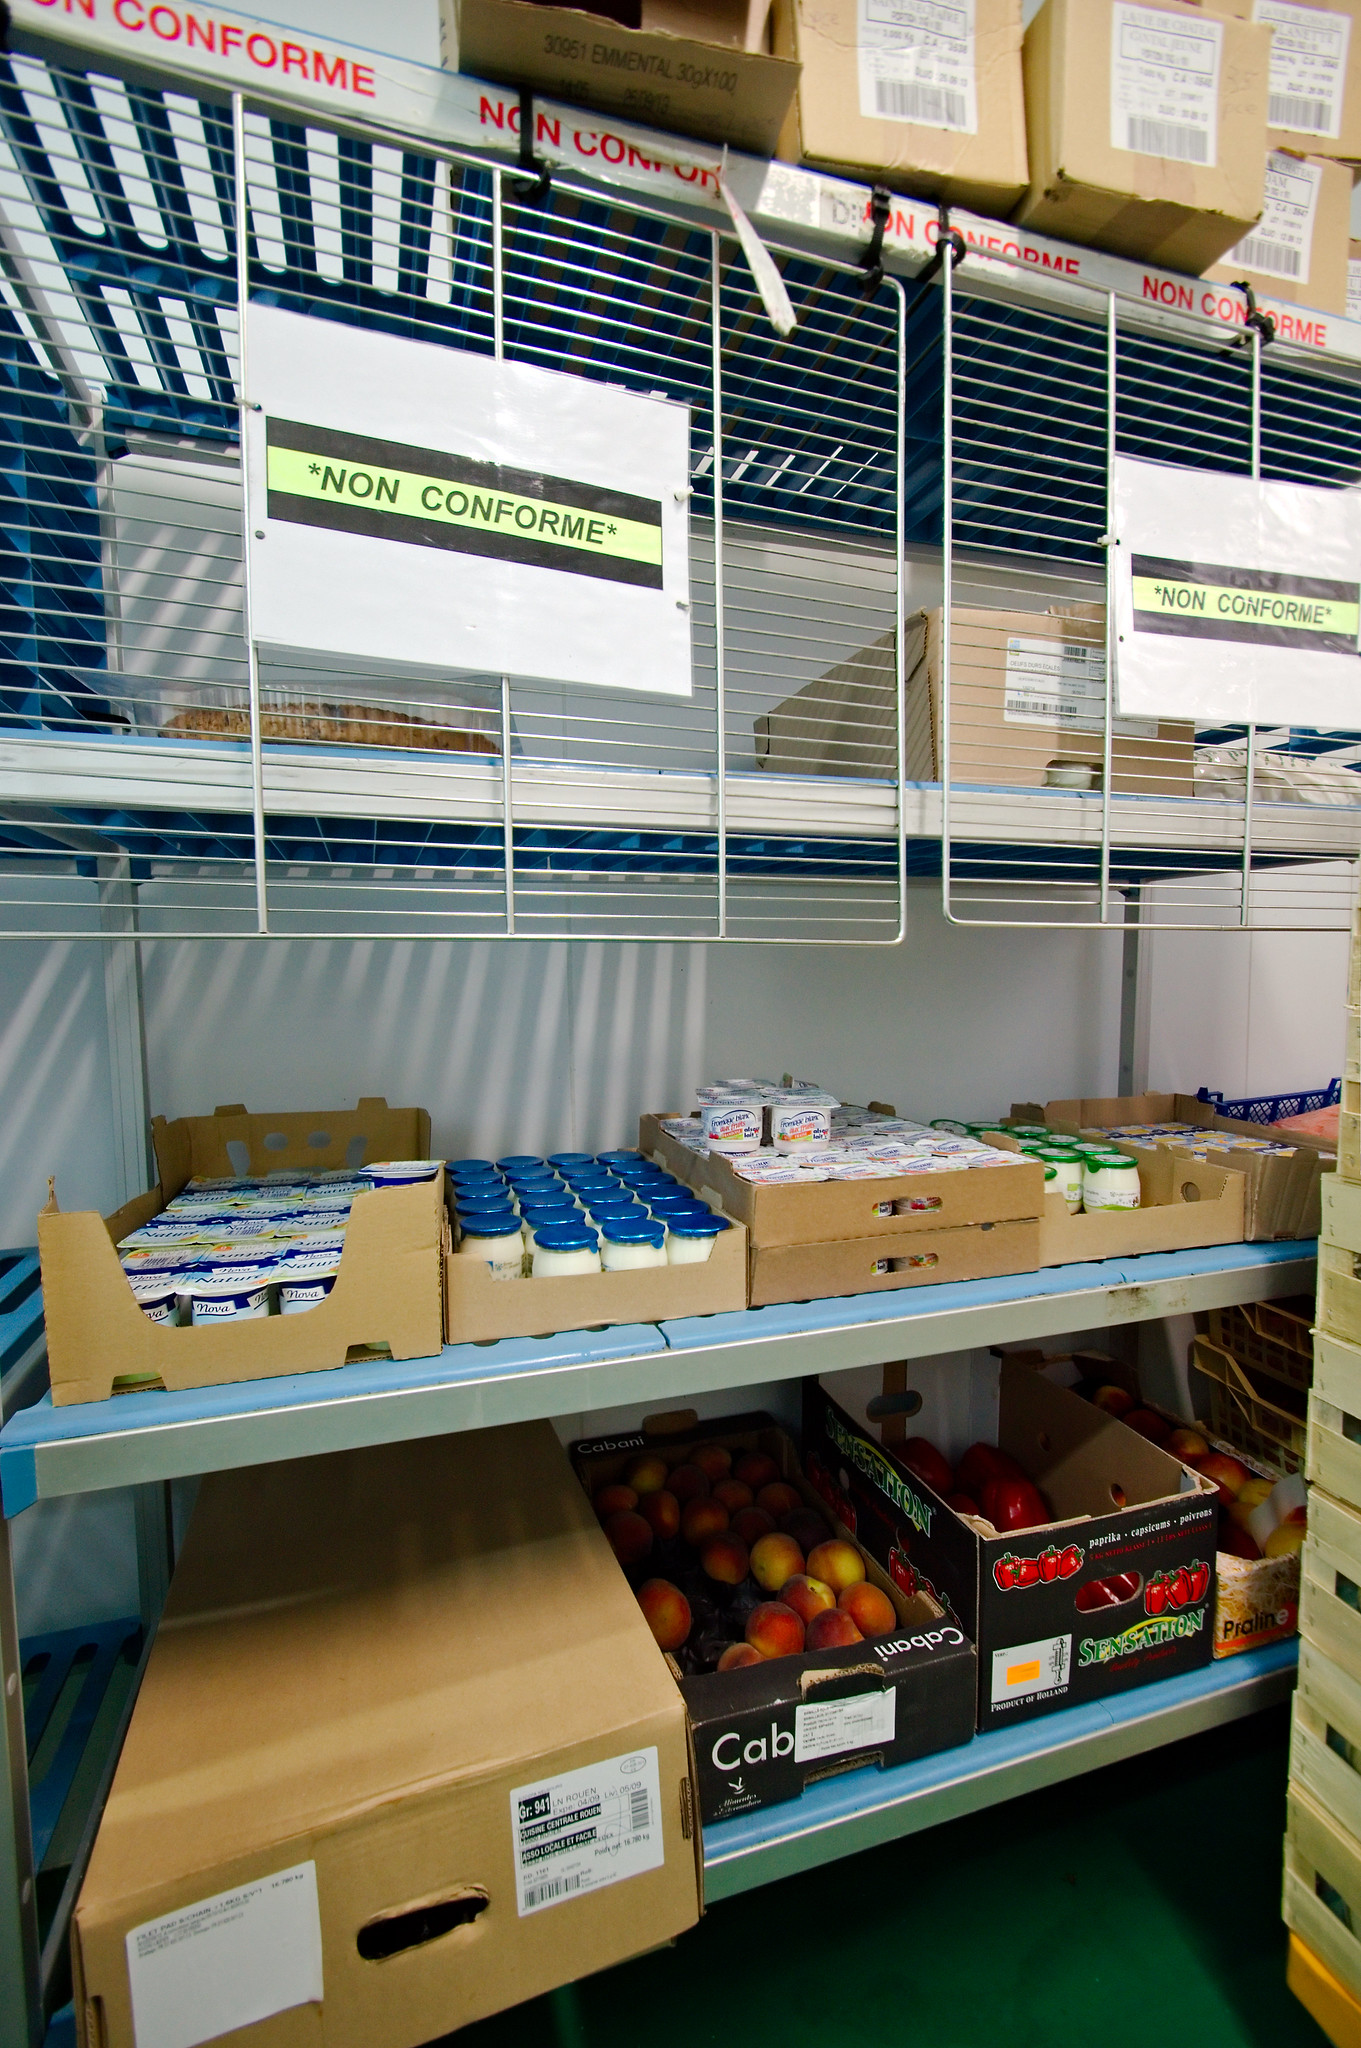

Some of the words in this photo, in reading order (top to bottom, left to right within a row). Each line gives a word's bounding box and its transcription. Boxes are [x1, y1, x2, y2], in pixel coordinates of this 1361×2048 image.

[112, 0, 376, 98] CONFORME
[591, 43, 673, 79] EMMENTAL
[1143, 274, 1194, 311] NON
[1201, 292, 1327, 347] CONORME
[197, 1273, 264, 1284] Nature
[286, 1289, 319, 1299] Nova
[196, 1303, 230, 1314] Nova
[577, 1436, 645, 1454] Cabani
[826, 1404, 933, 1539] SENSATION
[1089, 1532, 1121, 1549] paprika
[1131, 1519, 1171, 1538] capsicums
[1179, 1508, 1213, 1526] poivrons
[1078, 1608, 1206, 1667] SENSATION
[1223, 1608, 1290, 1639] Praline
[874, 1626, 965, 1662] Cabani
[991, 1697, 1025, 1713] PRODUCT
[1025, 1694, 1036, 1704] OF
[1036, 1686, 1069, 1701] HOLLAND
[711, 1722, 796, 1771] Cab
[519, 1804, 533, 1820] Gr:
[534, 1796, 550, 1815] 941
[552, 1799, 564, 1808] LN
[566, 1787, 597, 1802] ROUEN
[577, 1794, 600, 1808] 04/09
[619, 1781, 642, 1794] 05/09
[520, 1823, 546, 1842] CUISINE
[546, 1813, 579, 1831] CENTRALE
[579, 1806, 602, 1820] ROUEN
[522, 1847, 540, 1861] ASSO
[541, 1840, 566, 1855] LOCALE
[566, 1836, 575, 1847] ET
[575, 1829, 598, 1843] FACILE
[160, 1921, 177, 1932] PAD
